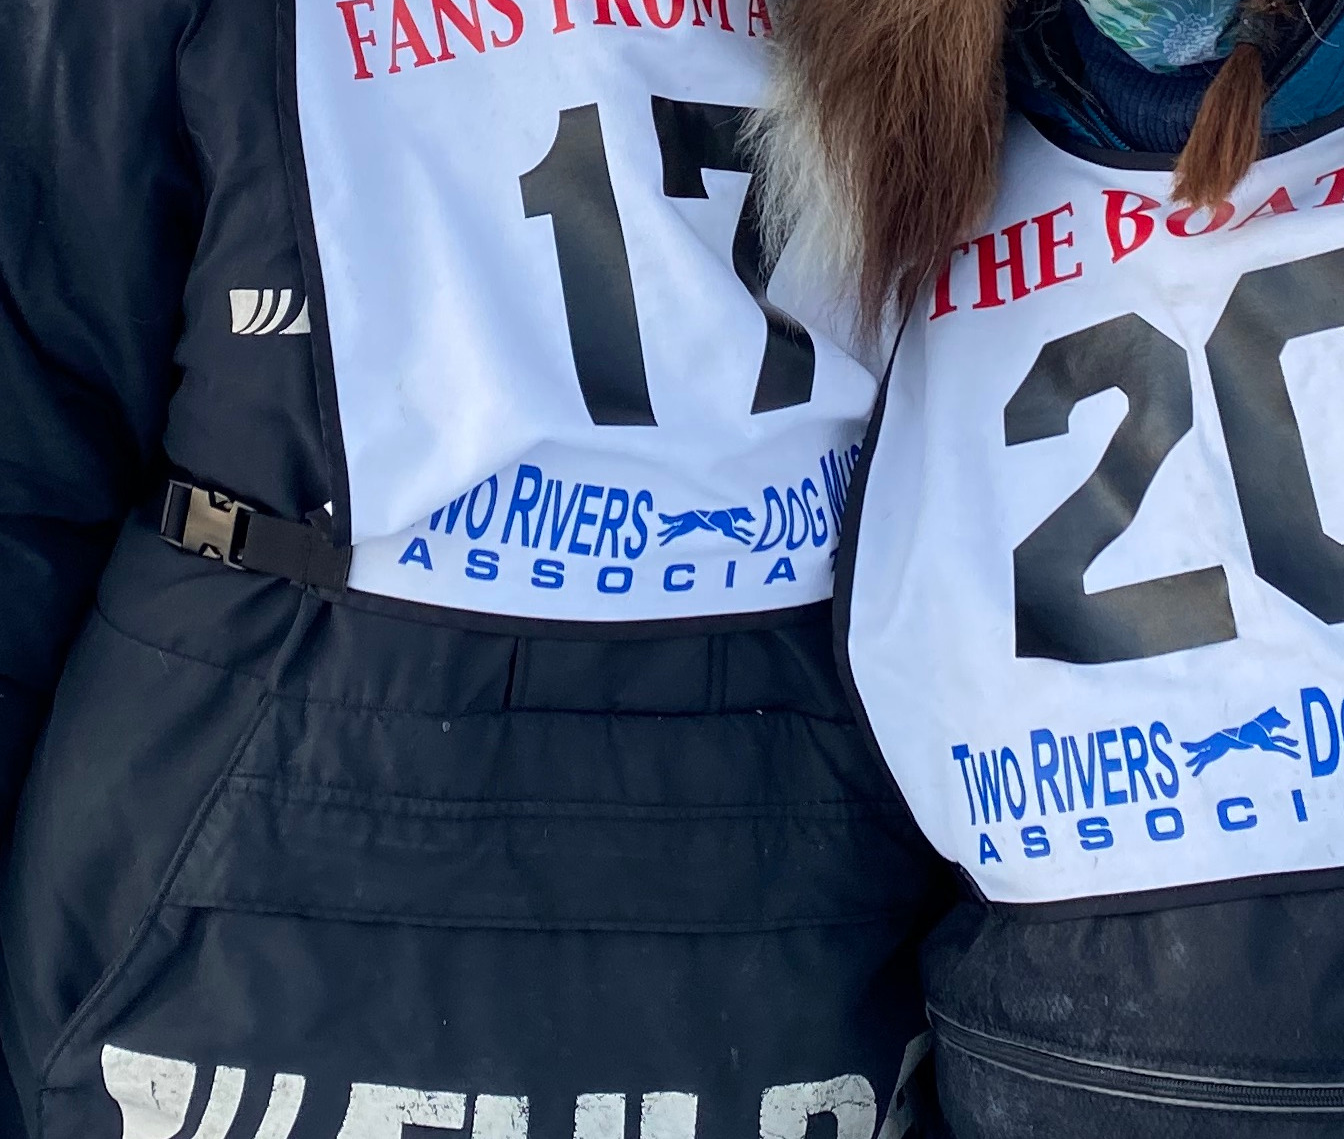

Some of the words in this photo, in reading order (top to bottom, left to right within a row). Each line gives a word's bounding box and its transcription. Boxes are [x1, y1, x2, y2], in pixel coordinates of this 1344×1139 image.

[518, 94, 816, 427] 17
[929, 201, 1083, 321] THE
[500, 462, 654, 561] RIVERS
[751, 477, 828, 553] DOG
[397, 536, 839, 597] ASSOCIA
[951, 743, 1027, 827] TWO
[1030, 720, 1180, 816] RIVERS
